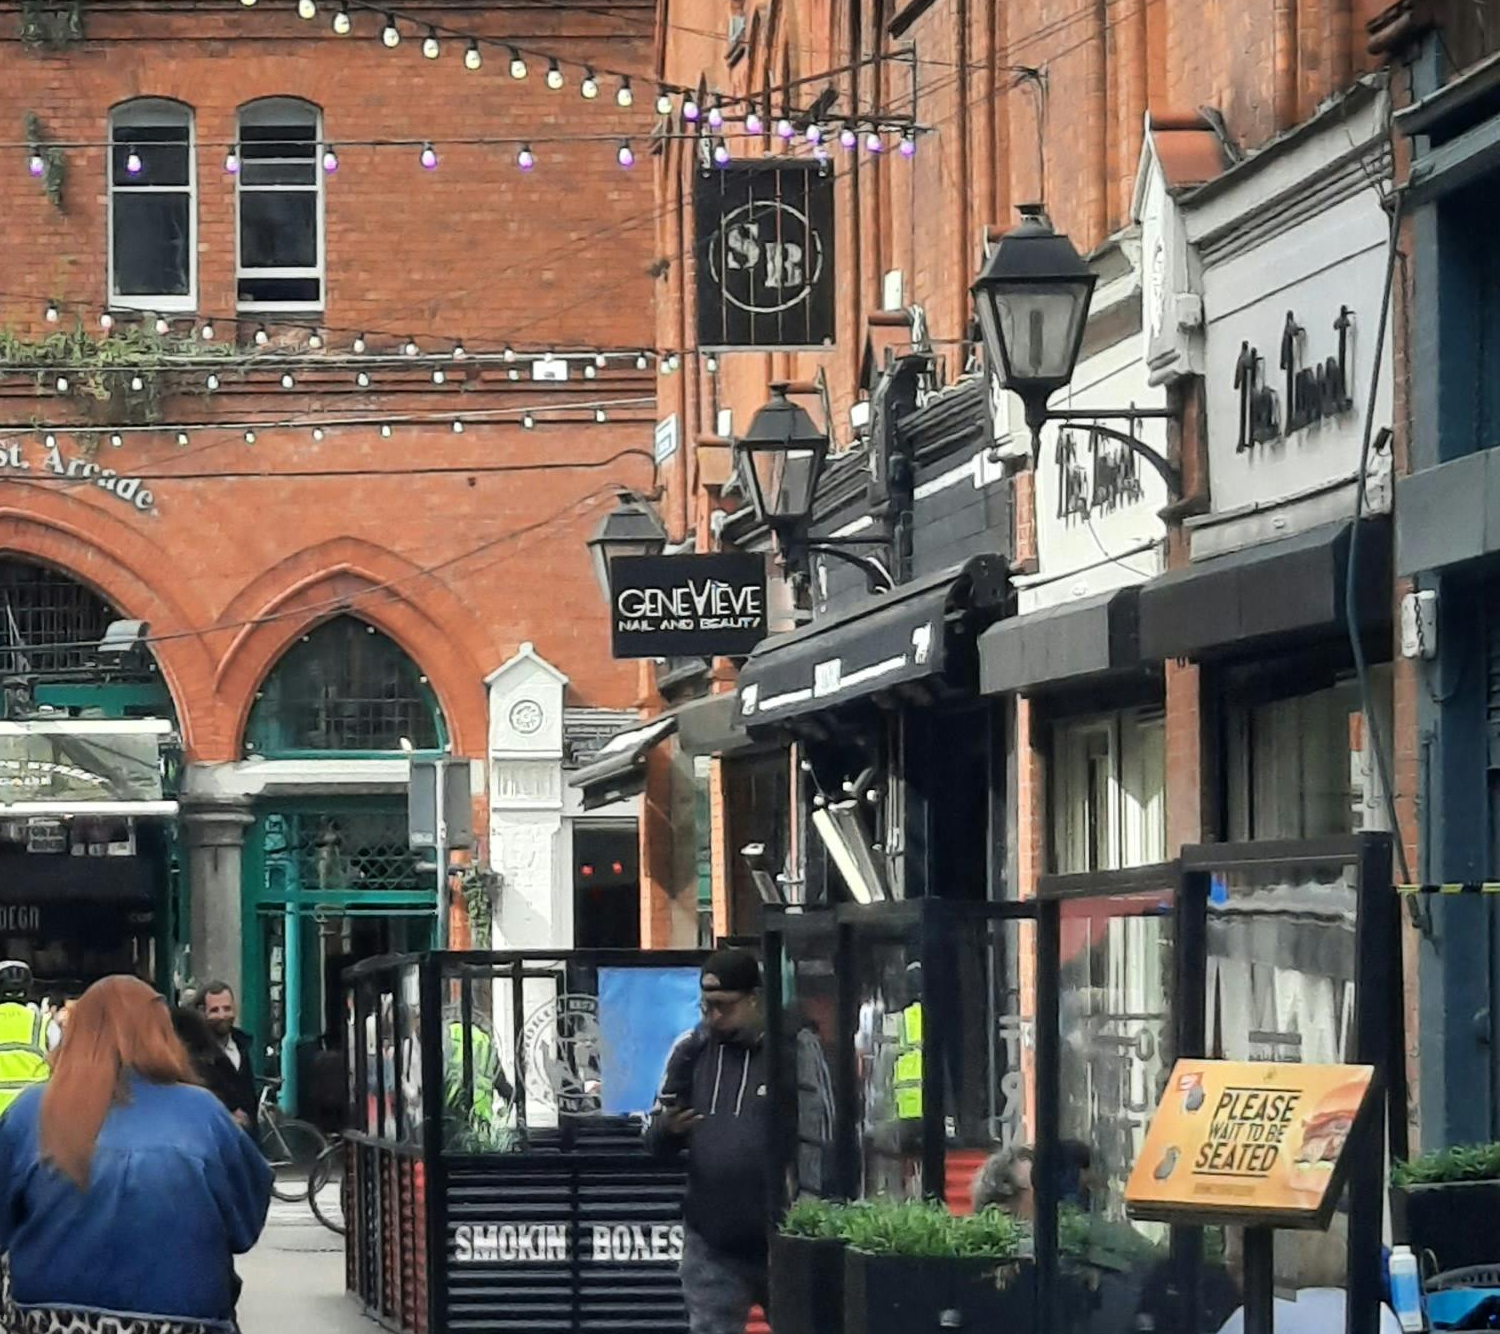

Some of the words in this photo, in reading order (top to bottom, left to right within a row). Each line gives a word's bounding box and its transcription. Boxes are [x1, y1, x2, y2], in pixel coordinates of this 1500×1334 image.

[618, 618, 655, 632] NAIL
[660, 618, 694, 631] AND
[700, 617, 761, 630] BEAUTY
[1213, 1092, 1301, 1122] PLEASE
[1209, 1122, 1246, 1141] WAIT
[1246, 1123, 1266, 1142] TO
[1265, 1124, 1289, 1143] BE
[1195, 1142, 1279, 1172] SEATED
[455, 1225, 567, 1261] SMOKIN
